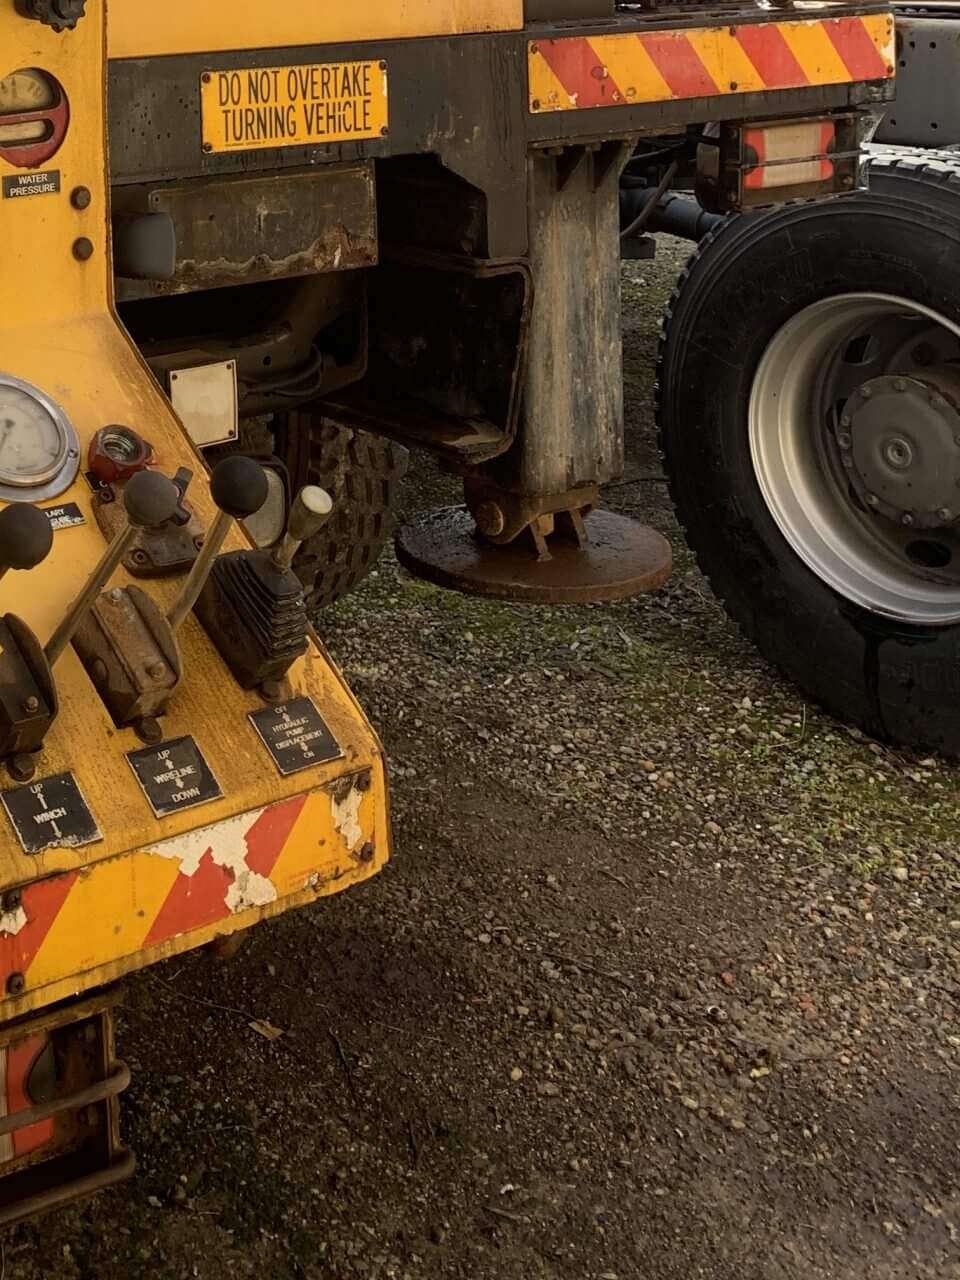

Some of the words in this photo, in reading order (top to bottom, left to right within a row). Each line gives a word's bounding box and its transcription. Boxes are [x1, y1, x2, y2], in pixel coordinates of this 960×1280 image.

[219, 73, 241, 106] DO
[248, 70, 280, 105] NOT
[288, 64, 372, 102] OVERTAKE
[222, 104, 296, 142] TURNING
[304, 99, 372, 136] VEHICLE
[18, 174, 48, 184] WATER
[10, 182, 56, 196] PRESSURE
[272, 716, 309, 732] HYDRAULIC
[285, 726, 304, 738] PUMP
[275, 730, 323, 750] DISPLACEMENT
[158, 750, 170, 759] UP
[153, 764, 197, 784] WIRELINE
[30, 784, 43, 794] UP
[172, 787, 200, 802] DOWN
[33, 807, 67, 824] WINCH
